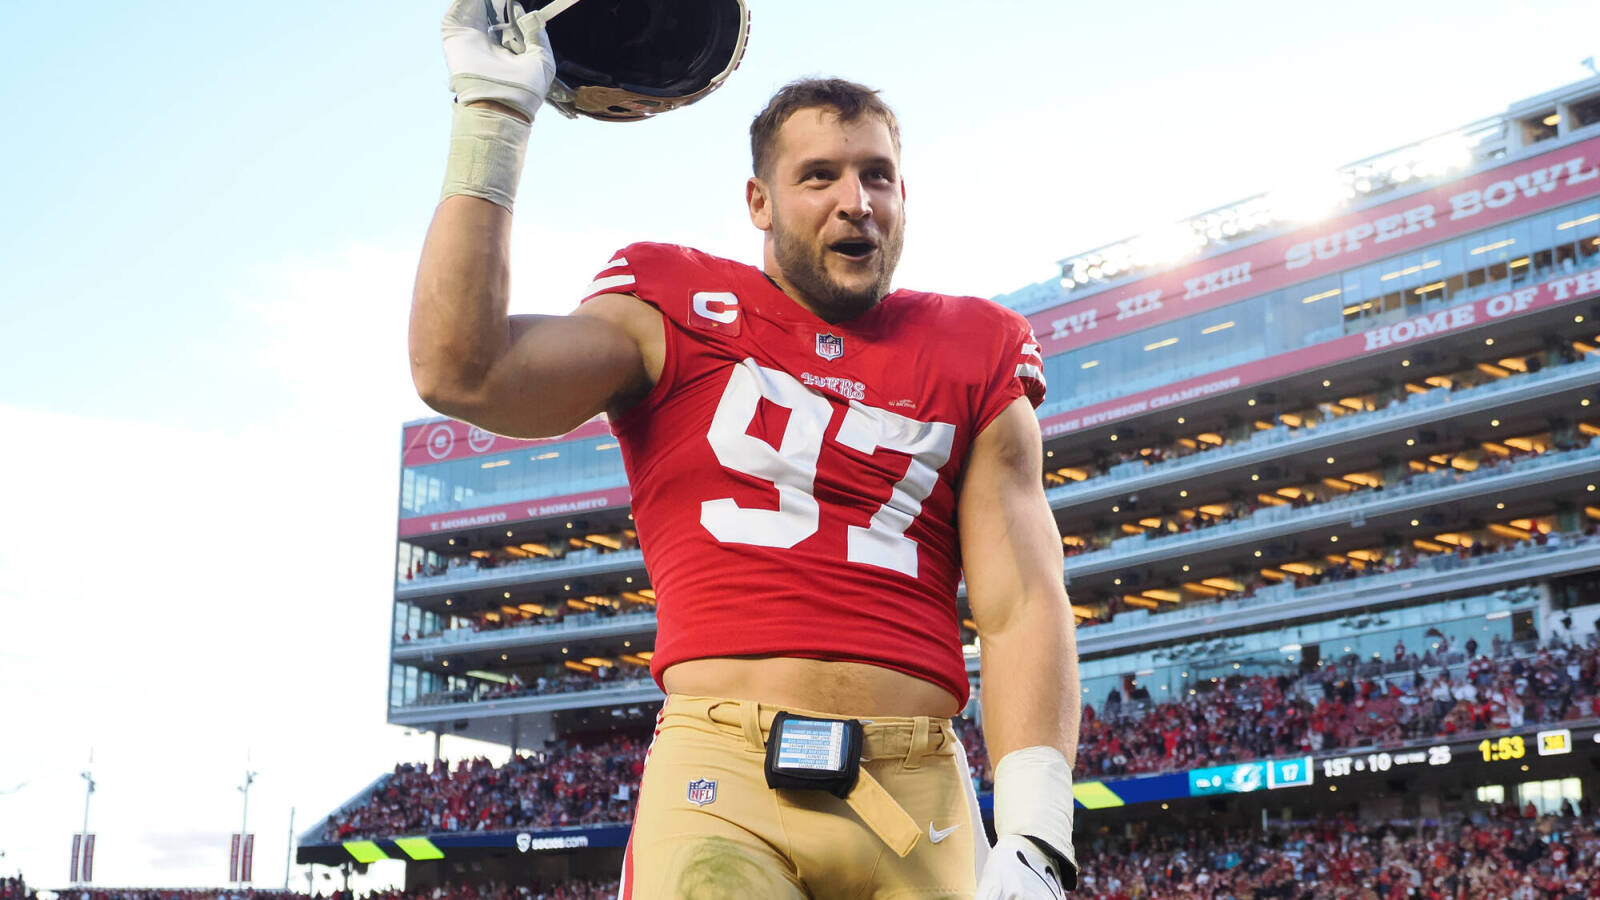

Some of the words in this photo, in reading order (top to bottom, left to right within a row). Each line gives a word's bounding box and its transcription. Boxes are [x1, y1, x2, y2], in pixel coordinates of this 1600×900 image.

[1285, 204, 1436, 270] SUPER
[1449, 156, 1599, 221] BOWL
[692, 291, 739, 325] C
[1051, 308, 1098, 341] XVI
[1116, 289, 1164, 321] XIX
[1183, 261, 1253, 300] XXIII
[1364, 304, 1475, 351] HOME
[1486, 286, 1539, 318] OF
[820, 343, 840, 355] NFL
[800, 372, 866, 401] 49ERS
[1083, 402, 1148, 428] DIVISION
[1151, 375, 1241, 409] CHAMPIONS
[699, 357, 957, 579] 97
[538, 497, 609, 516] MORABITO
[441, 512, 507, 531] MORABITO
[1478, 735, 1526, 763] 1:53
[1281, 763, 1299, 782] 17
[1323, 756, 1353, 778] 1ST
[1367, 752, 1392, 773] 10
[690, 790, 713, 801] NFL
